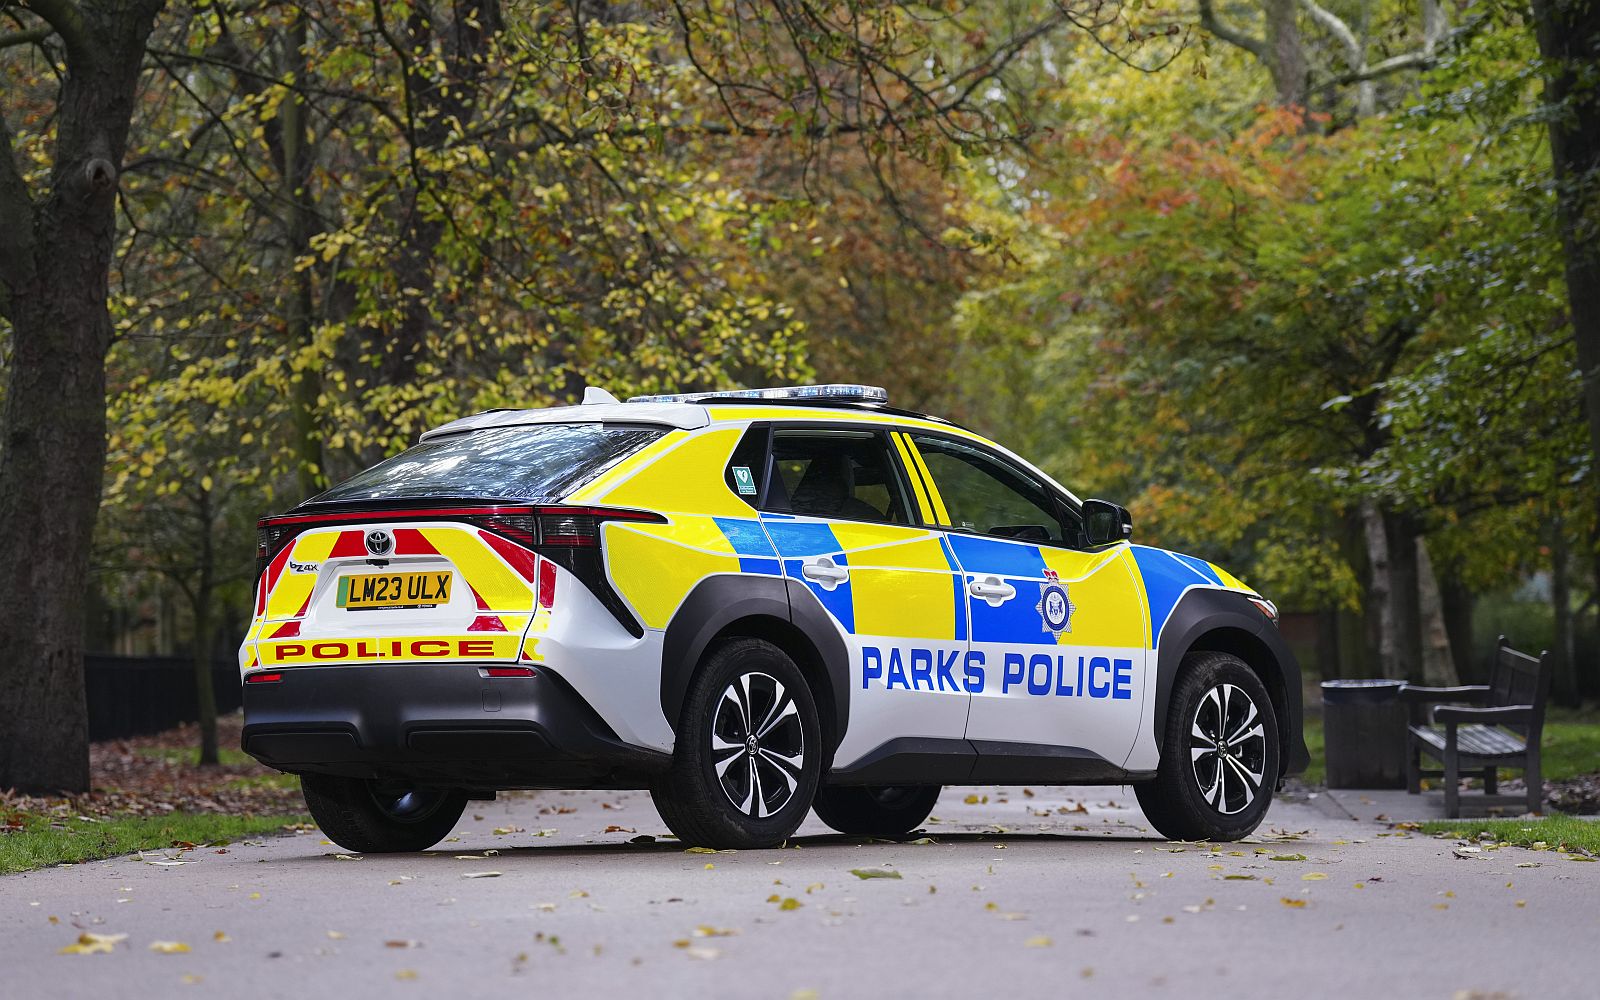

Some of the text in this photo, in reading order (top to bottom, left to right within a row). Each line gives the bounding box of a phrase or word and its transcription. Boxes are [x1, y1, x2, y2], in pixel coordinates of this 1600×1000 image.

[349, 574, 449, 602] LM23 ULX
[276, 640, 495, 660] POLICE
[862, 646, 1132, 699] PARKS POLICE
